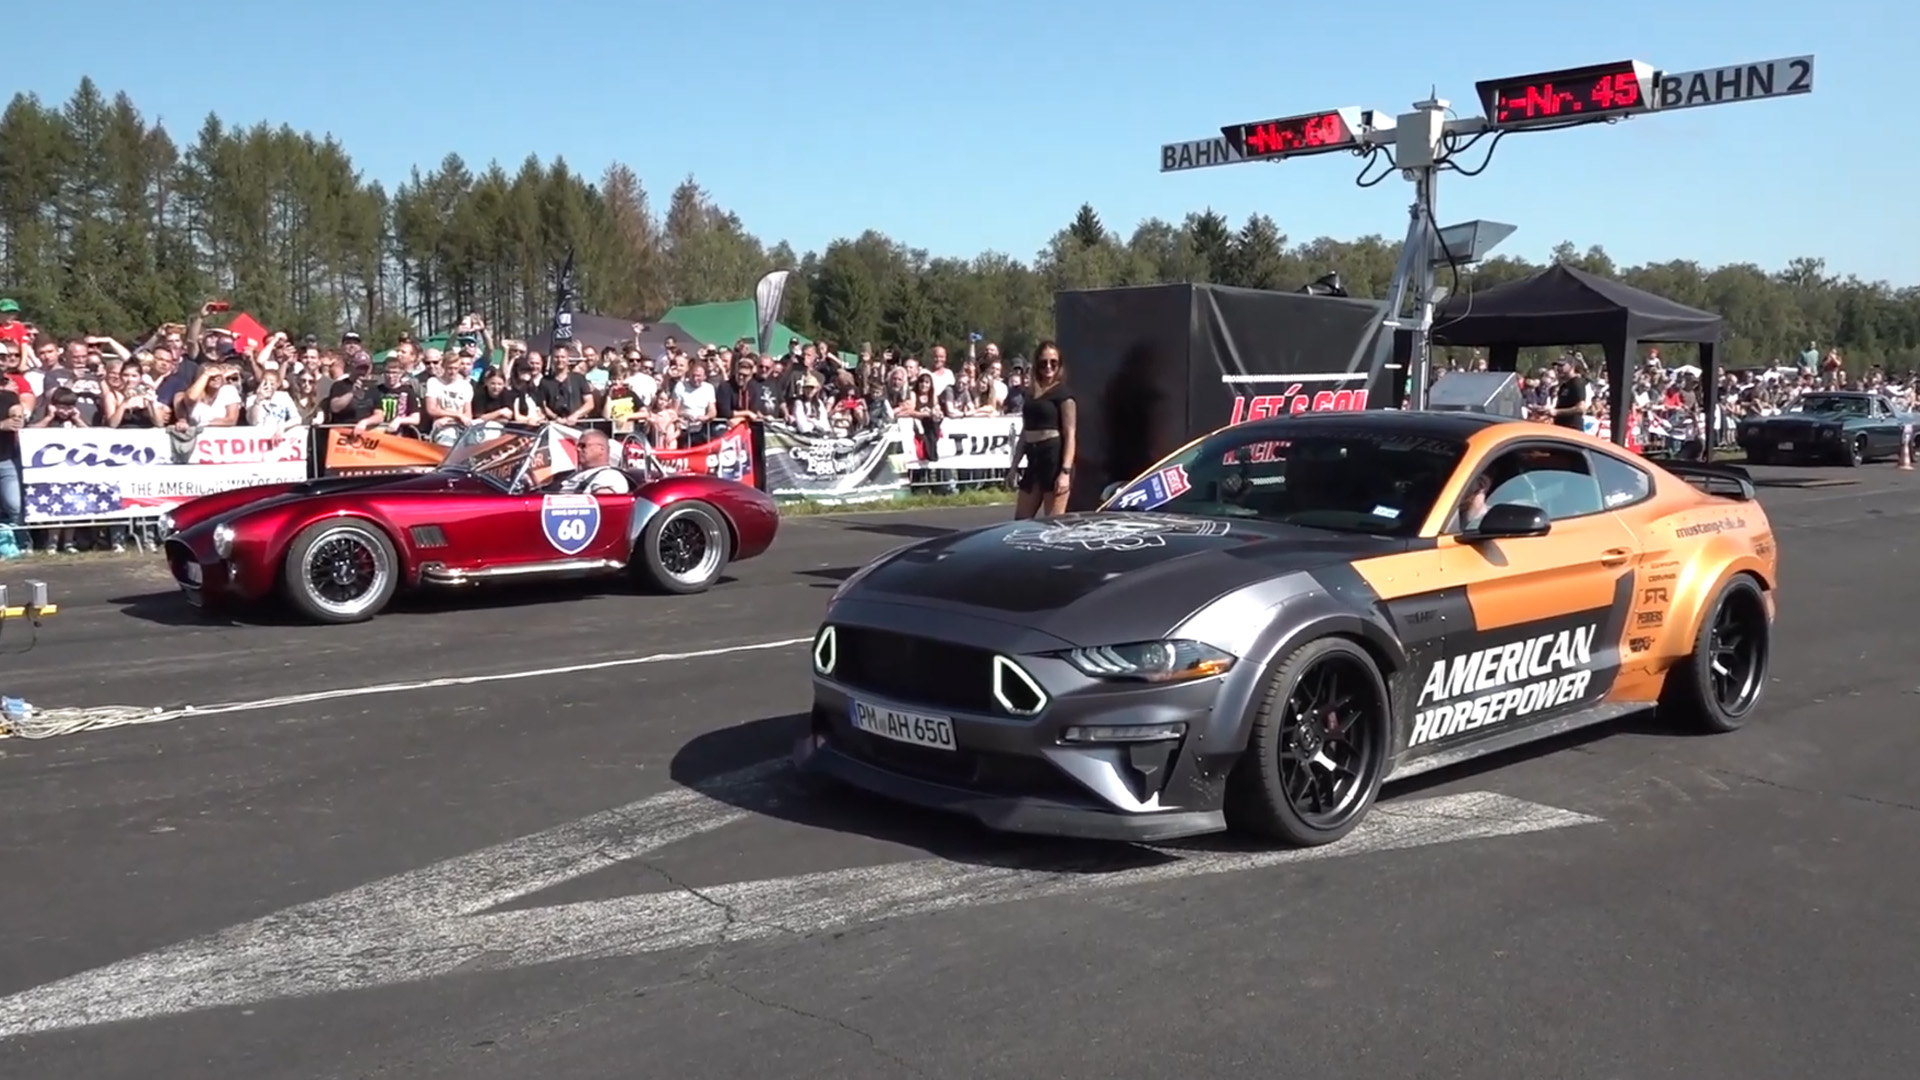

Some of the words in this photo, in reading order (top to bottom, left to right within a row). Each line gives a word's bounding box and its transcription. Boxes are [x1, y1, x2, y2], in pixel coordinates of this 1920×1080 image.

[1592, 72, 1638, 108] 45
[1662, 63, 1775, 107] BAHN
[1788, 60, 1811, 92] 2
[1305, 115, 1341, 146] 60
[1163, 140, 1229, 169] BAHN
[131, 482, 153, 496] THE
[557, 518, 587, 541] 60
[1643, 587, 1668, 605] RTR
[1416, 623, 1597, 707] AMERICAN
[857, 703, 878, 730] PM
[888, 712, 911, 739] AH
[914, 717, 951, 745] 650
[1408, 669, 1592, 747] HORSEPOWER
